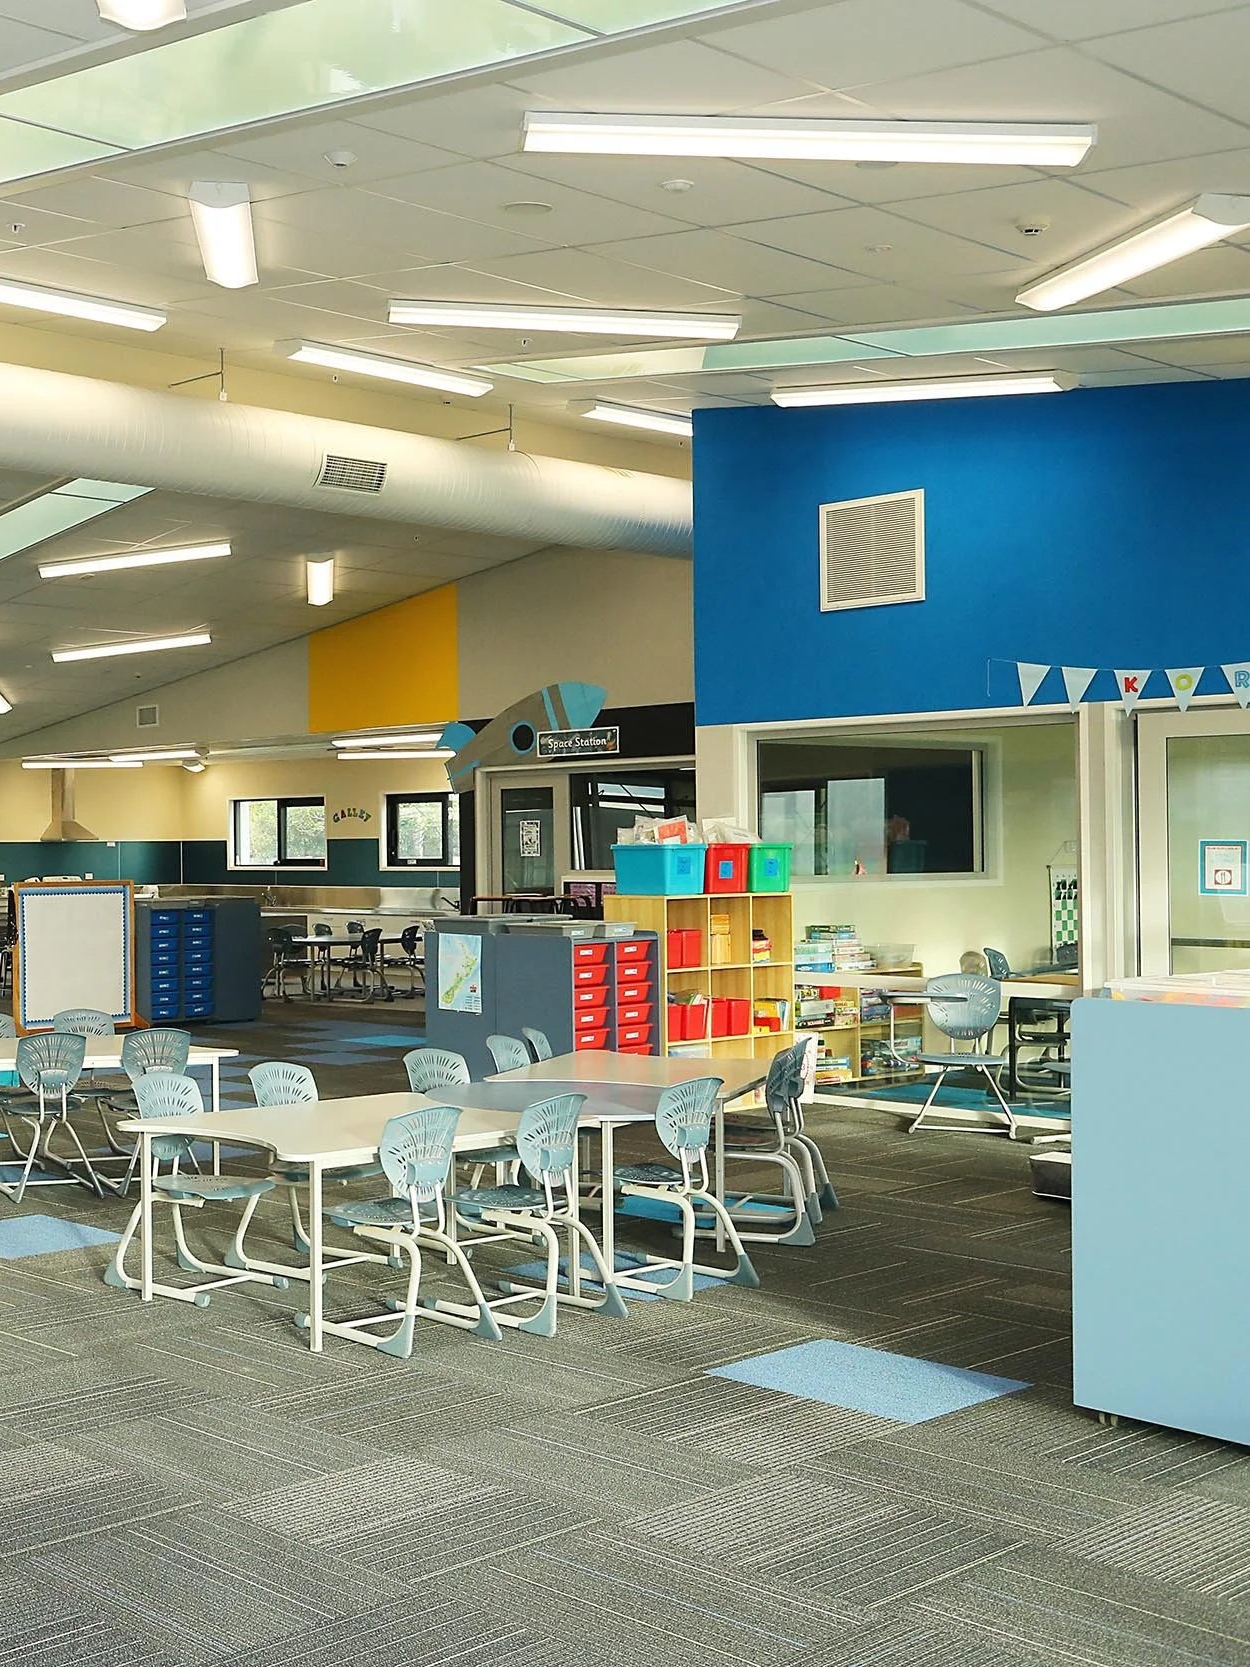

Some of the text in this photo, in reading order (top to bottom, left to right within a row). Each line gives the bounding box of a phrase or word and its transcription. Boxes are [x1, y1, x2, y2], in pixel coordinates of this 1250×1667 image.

[548, 736, 607, 752] Space Station
[333, 807, 372, 823] GALLEY
